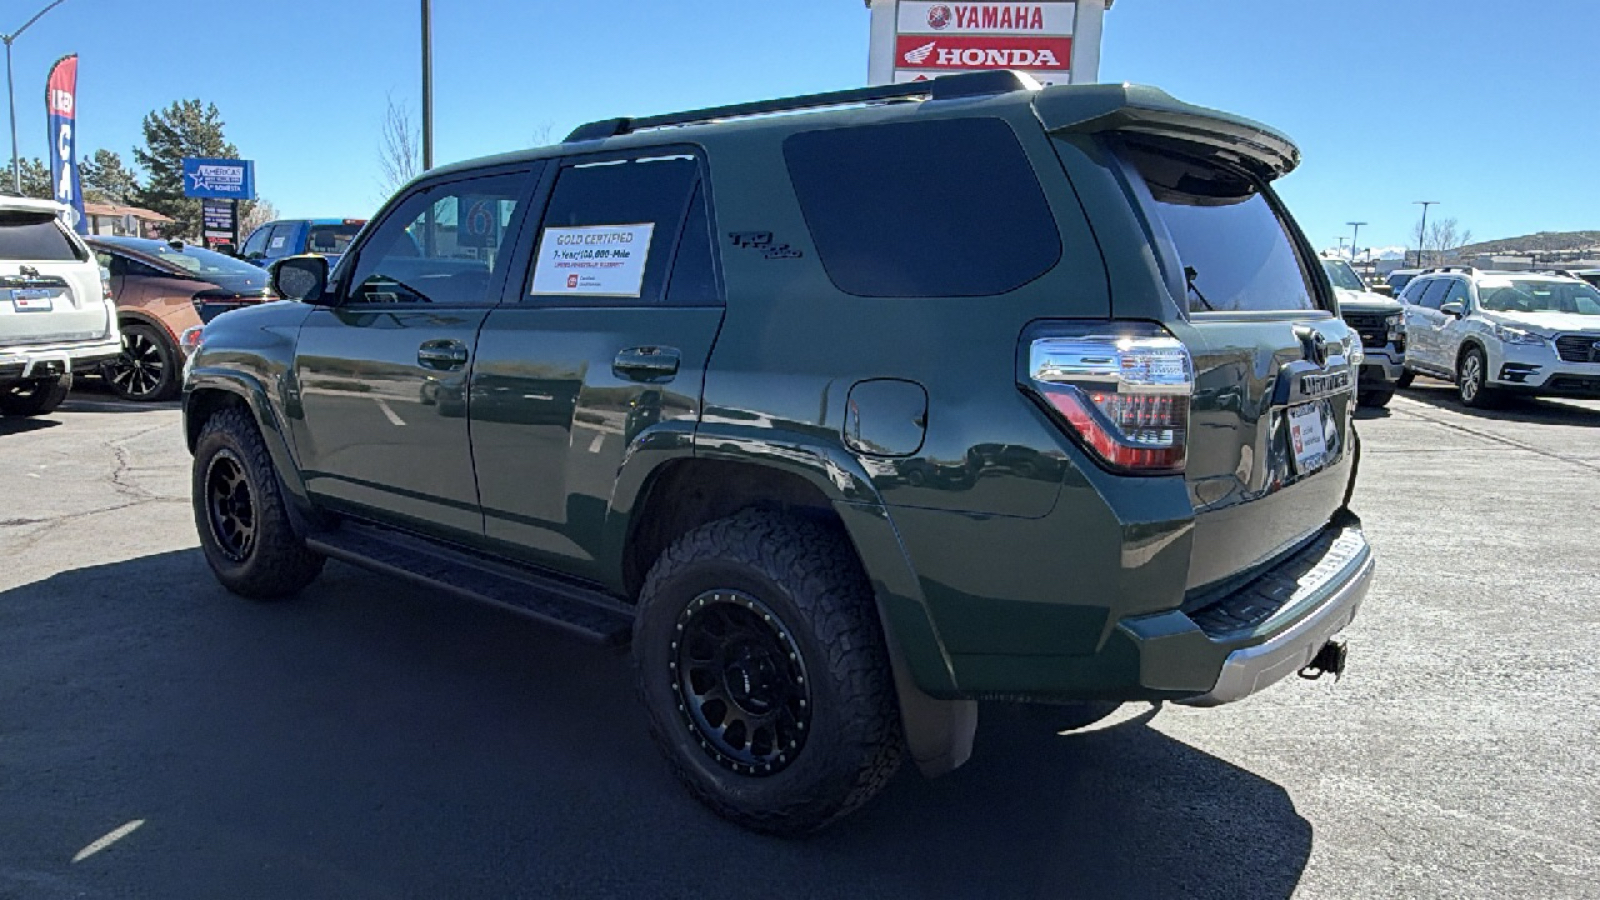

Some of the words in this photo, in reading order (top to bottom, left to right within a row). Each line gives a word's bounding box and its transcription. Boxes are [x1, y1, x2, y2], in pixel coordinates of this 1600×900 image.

[955, 6, 1043, 29] YAMAHA
[936, 48, 1060, 66] HONDA
[466, 200, 493, 235] 6
[557, 234, 584, 246] GOLD
[585, 232, 633, 245] CERTIFIED
